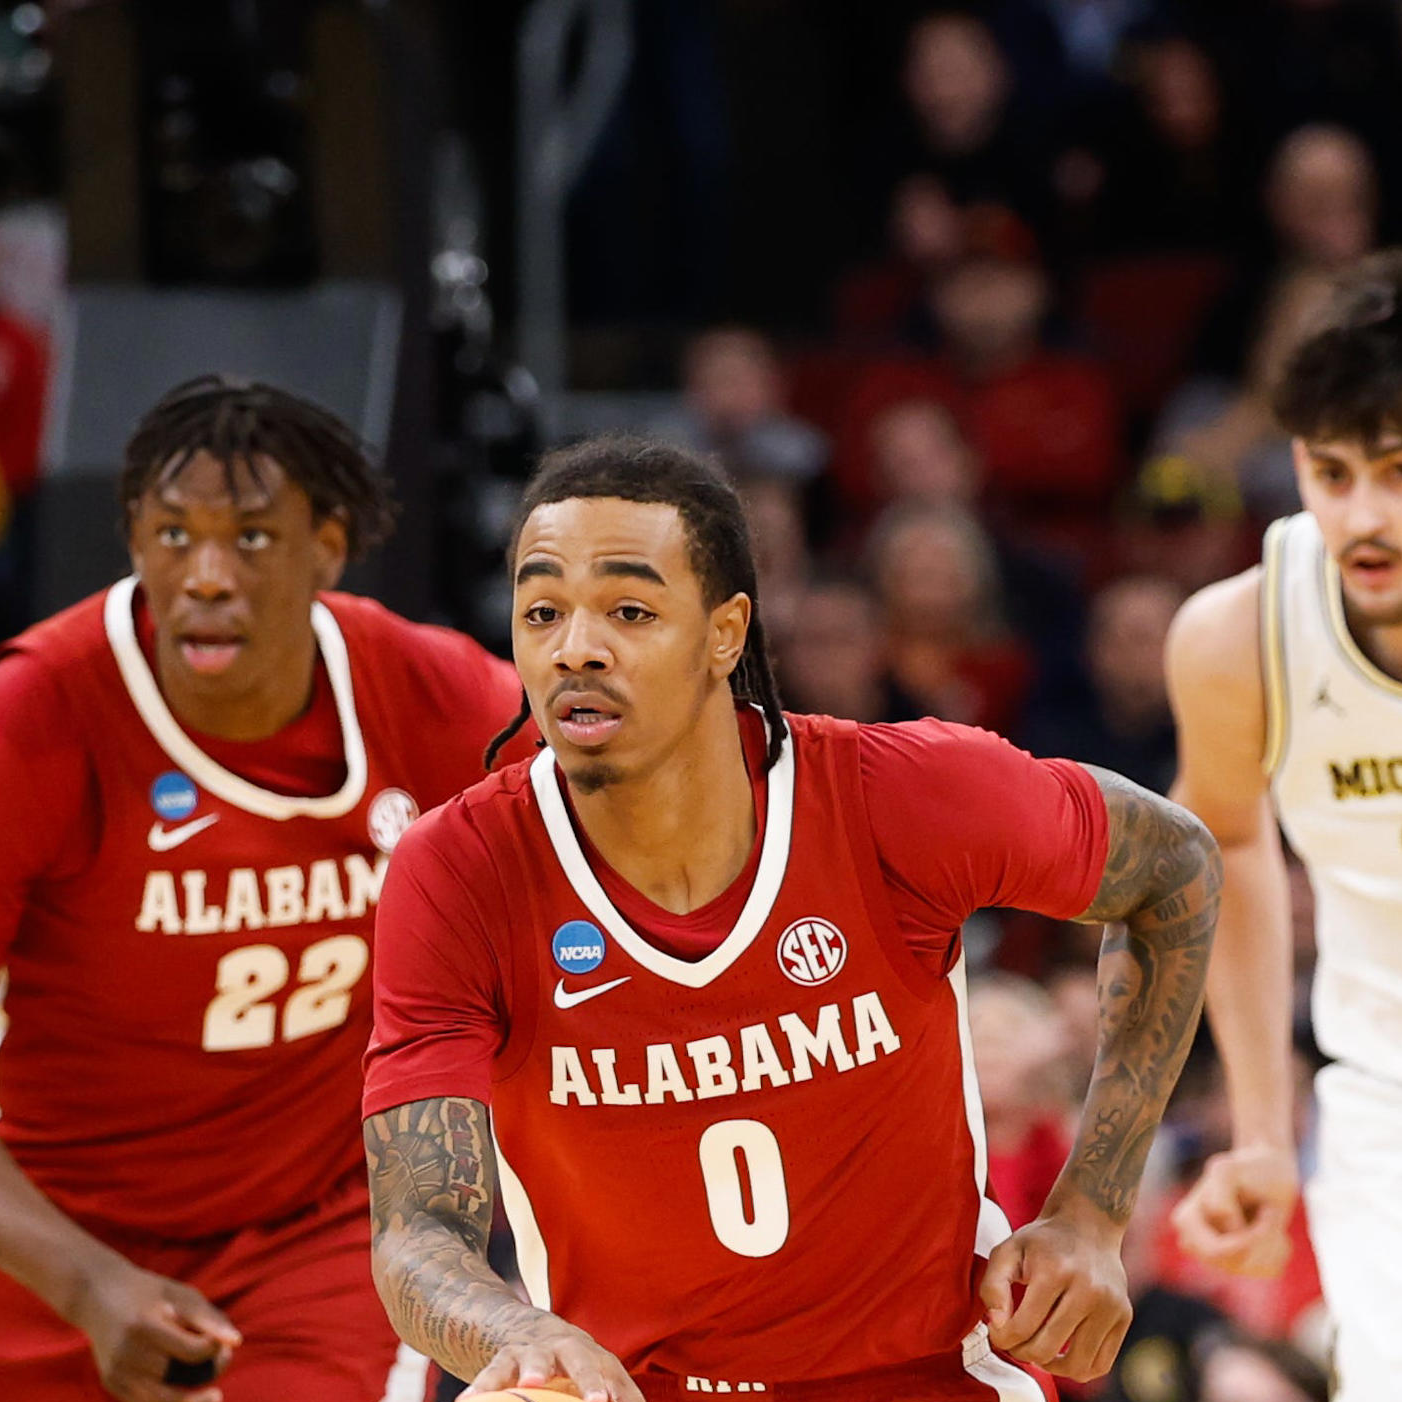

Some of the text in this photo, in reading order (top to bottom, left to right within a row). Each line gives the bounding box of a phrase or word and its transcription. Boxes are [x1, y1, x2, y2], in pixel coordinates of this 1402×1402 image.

[201, 933, 369, 1052] 22
[559, 945, 602, 961] NCAA
[782, 922, 841, 982] SEC
[549, 991, 901, 1106] ALABAMA
[698, 1118, 790, 1258] 0
